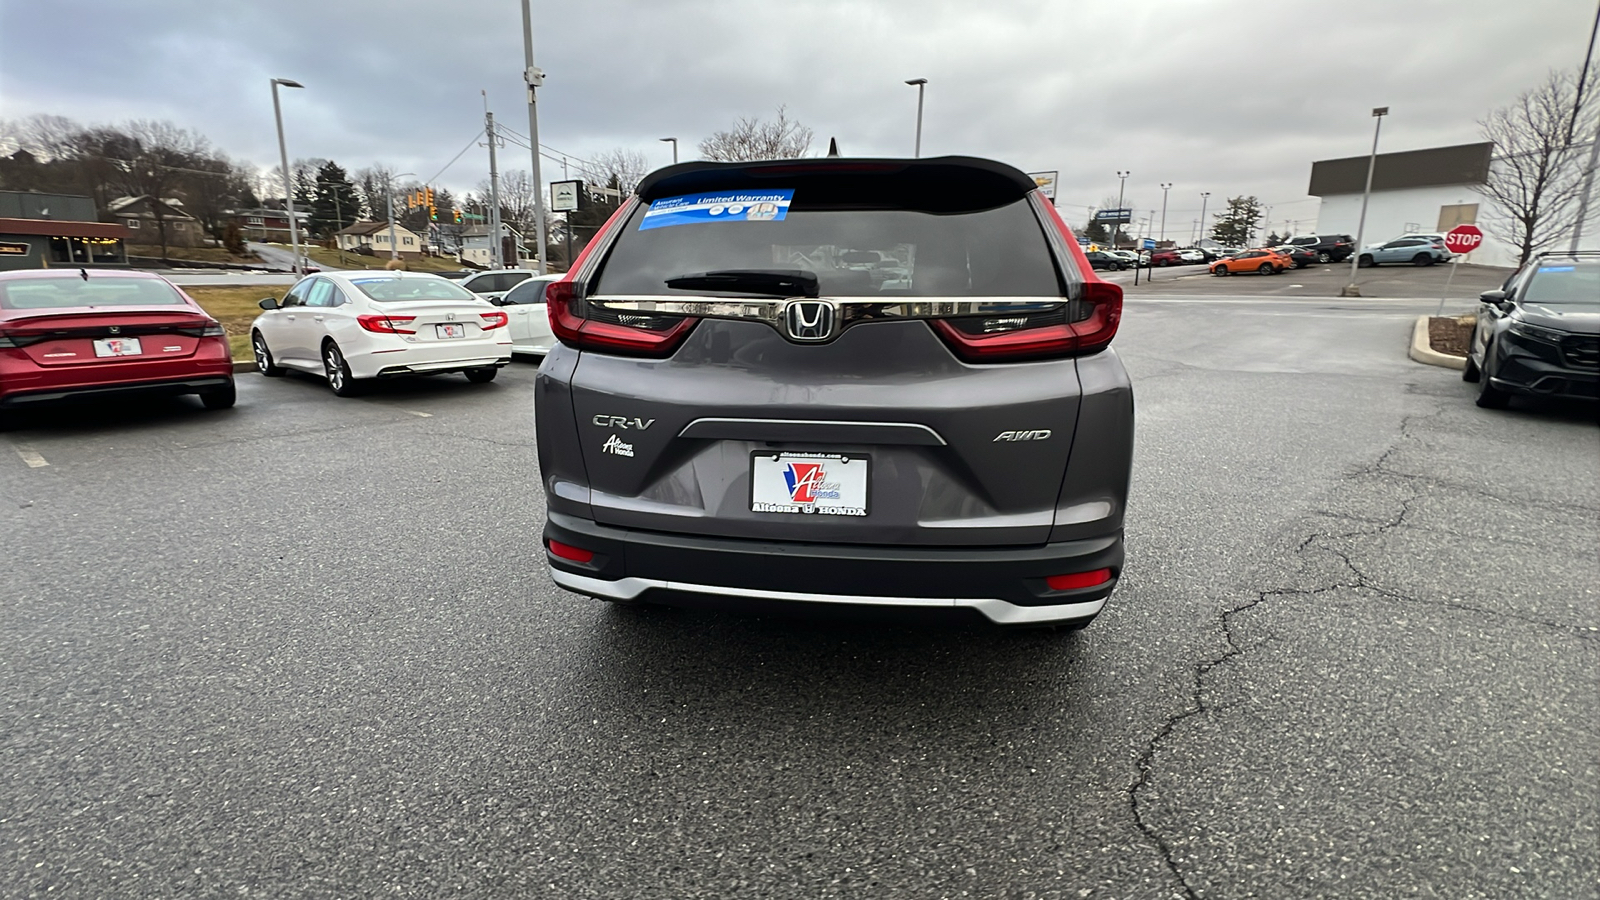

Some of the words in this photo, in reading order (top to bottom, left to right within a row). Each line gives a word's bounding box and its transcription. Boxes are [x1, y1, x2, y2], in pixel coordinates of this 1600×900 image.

[697, 195, 735, 205] Limited
[735, 194, 785, 202] Warranty
[1446, 233, 1481, 246] STOP
[592, 414, 656, 431] CR-V
[992, 429, 1052, 442] AWD
[614, 447, 635, 458] Honda
[780, 451, 842, 459] altoonahonda.com
[811, 490, 840, 498] Honda
[752, 503, 800, 513] Altoona
[818, 506, 867, 516] HONDA
